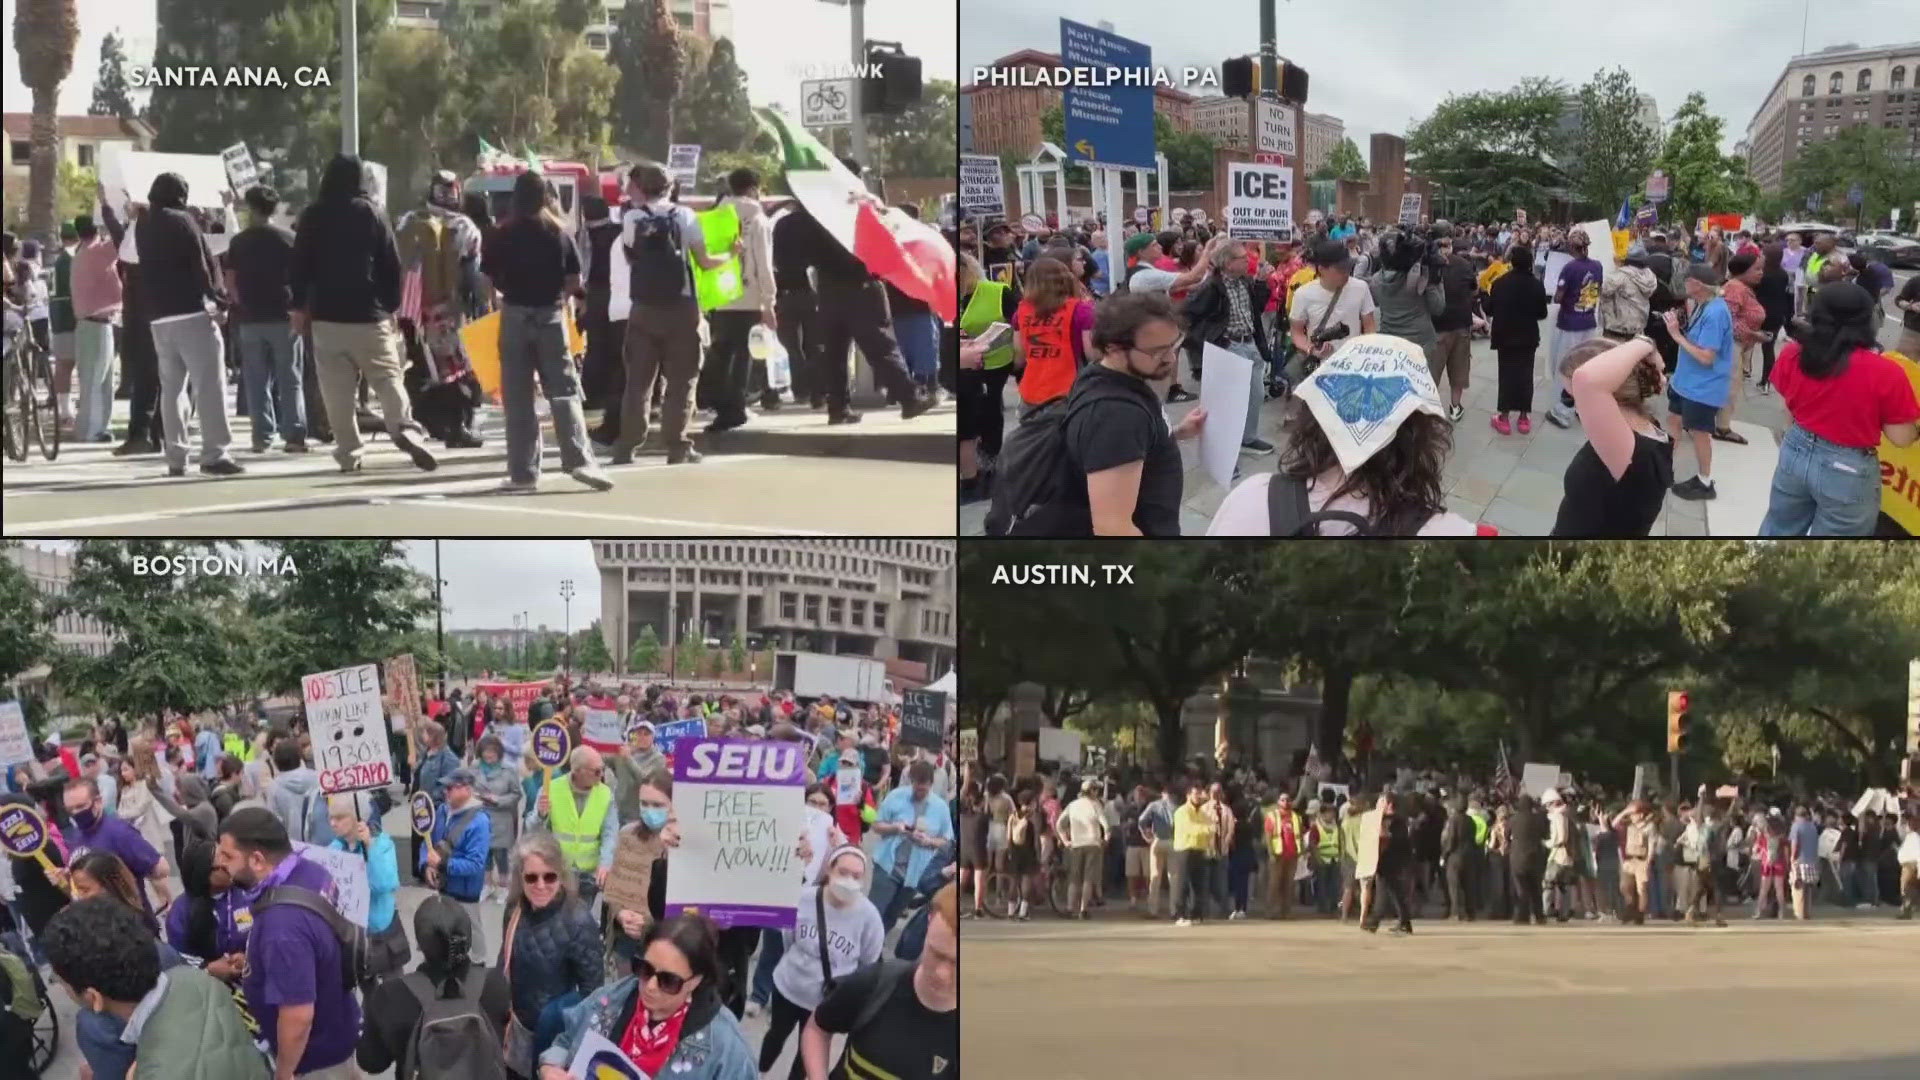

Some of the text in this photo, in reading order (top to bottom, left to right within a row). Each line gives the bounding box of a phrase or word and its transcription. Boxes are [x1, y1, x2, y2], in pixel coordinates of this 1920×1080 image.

[1068, 39, 1107, 57] Jewish
[1071, 97, 1123, 116] American
[1269, 107, 1284, 120] NO
[1071, 108, 1120, 125] Museum
[1264, 122, 1291, 137] TURN
[1261, 136, 1294, 153] ON RED
[1233, 170, 1287, 200] ICE:
[1232, 207, 1289, 218] OUT OF OUR
[1350, 343, 1394, 356] PUEBLO
[336, 666, 374, 698] ICE
[905, 691, 933, 708] ICE
[686, 742, 797, 780] SEIU
[703, 789, 769, 820] FREE
[709, 818, 777, 844] THEM
[714, 845, 791, 873] NOW!!!
[800, 924, 855, 956] BOTON
